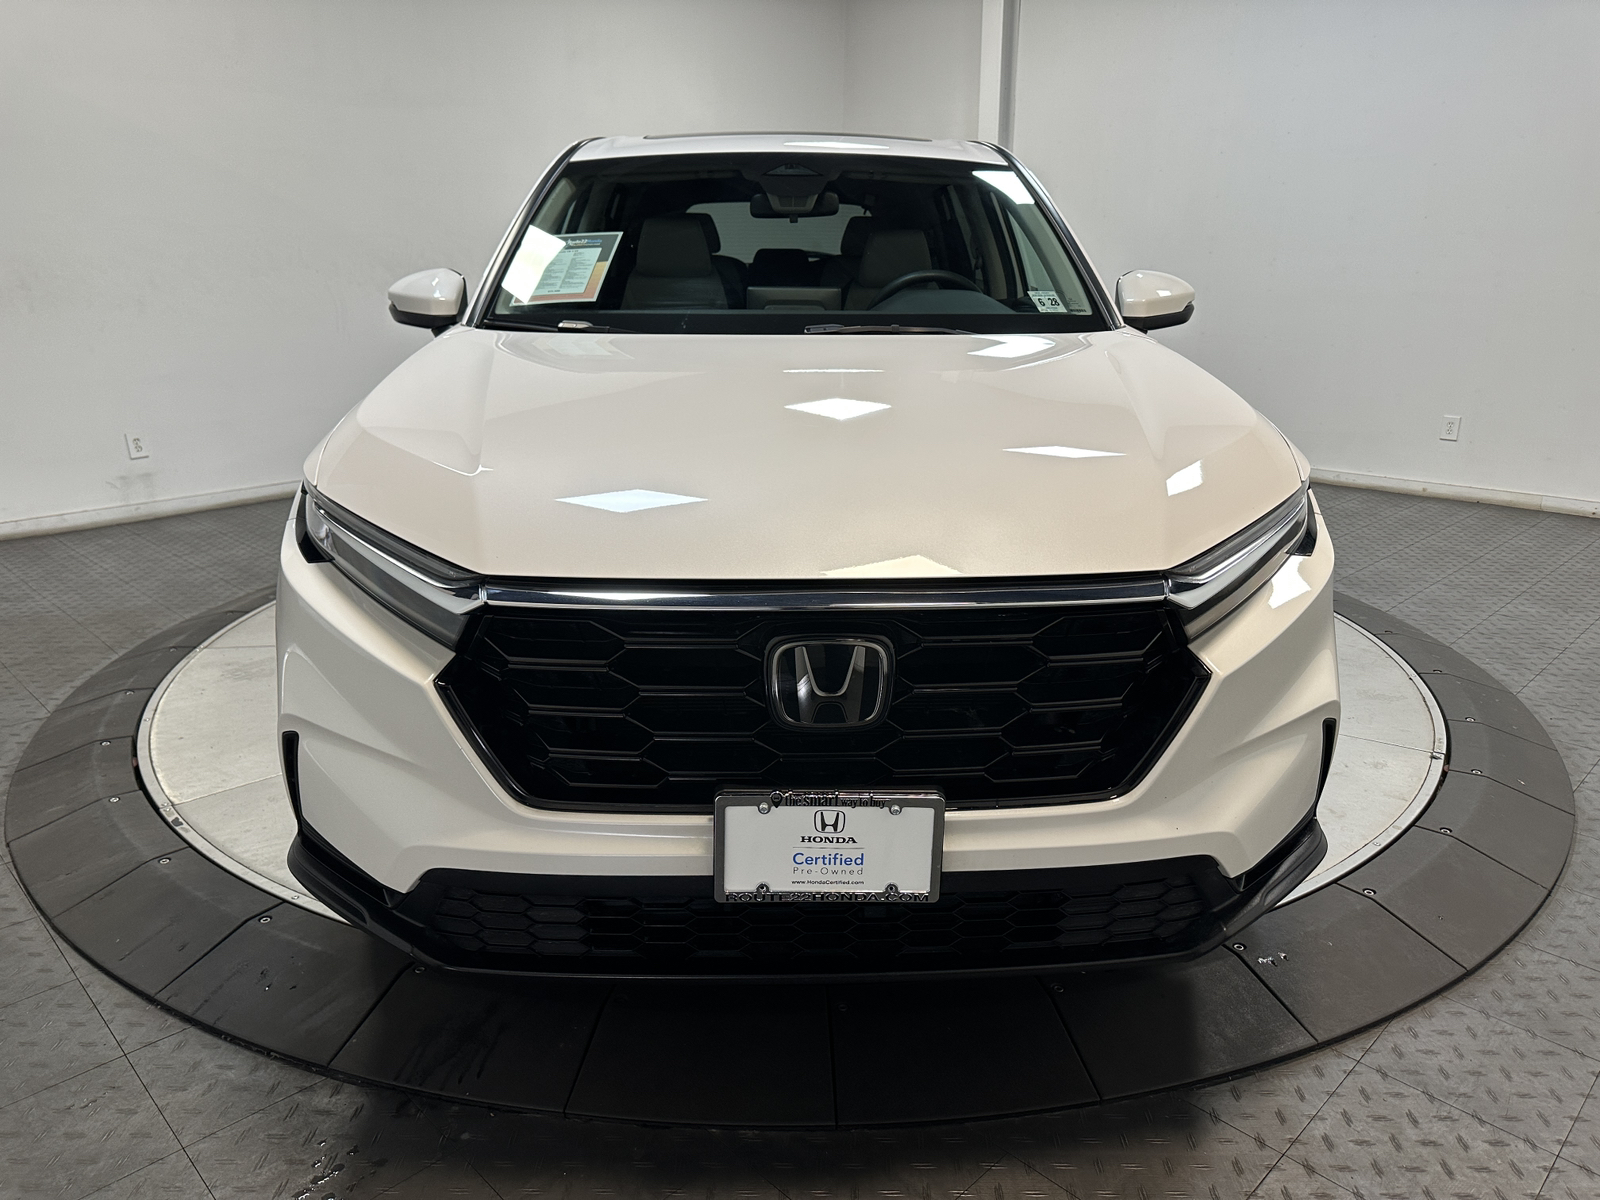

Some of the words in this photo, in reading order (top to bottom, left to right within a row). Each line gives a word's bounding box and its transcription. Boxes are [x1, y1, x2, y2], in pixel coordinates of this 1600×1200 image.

[1038, 298, 1045, 306] 6
[1048, 298, 1060, 306] 28
[785, 790, 801, 807] the
[803, 790, 839, 807] smart
[841, 798, 858, 809] way
[859, 795, 868, 807] to
[870, 791, 886, 809] buy
[800, 836, 858, 844] HONDA
[792, 852, 865, 866] Certified
[792, 867, 864, 876] Pre-Owned
[725, 892, 930, 903] ROUTE22HONDA.COM
